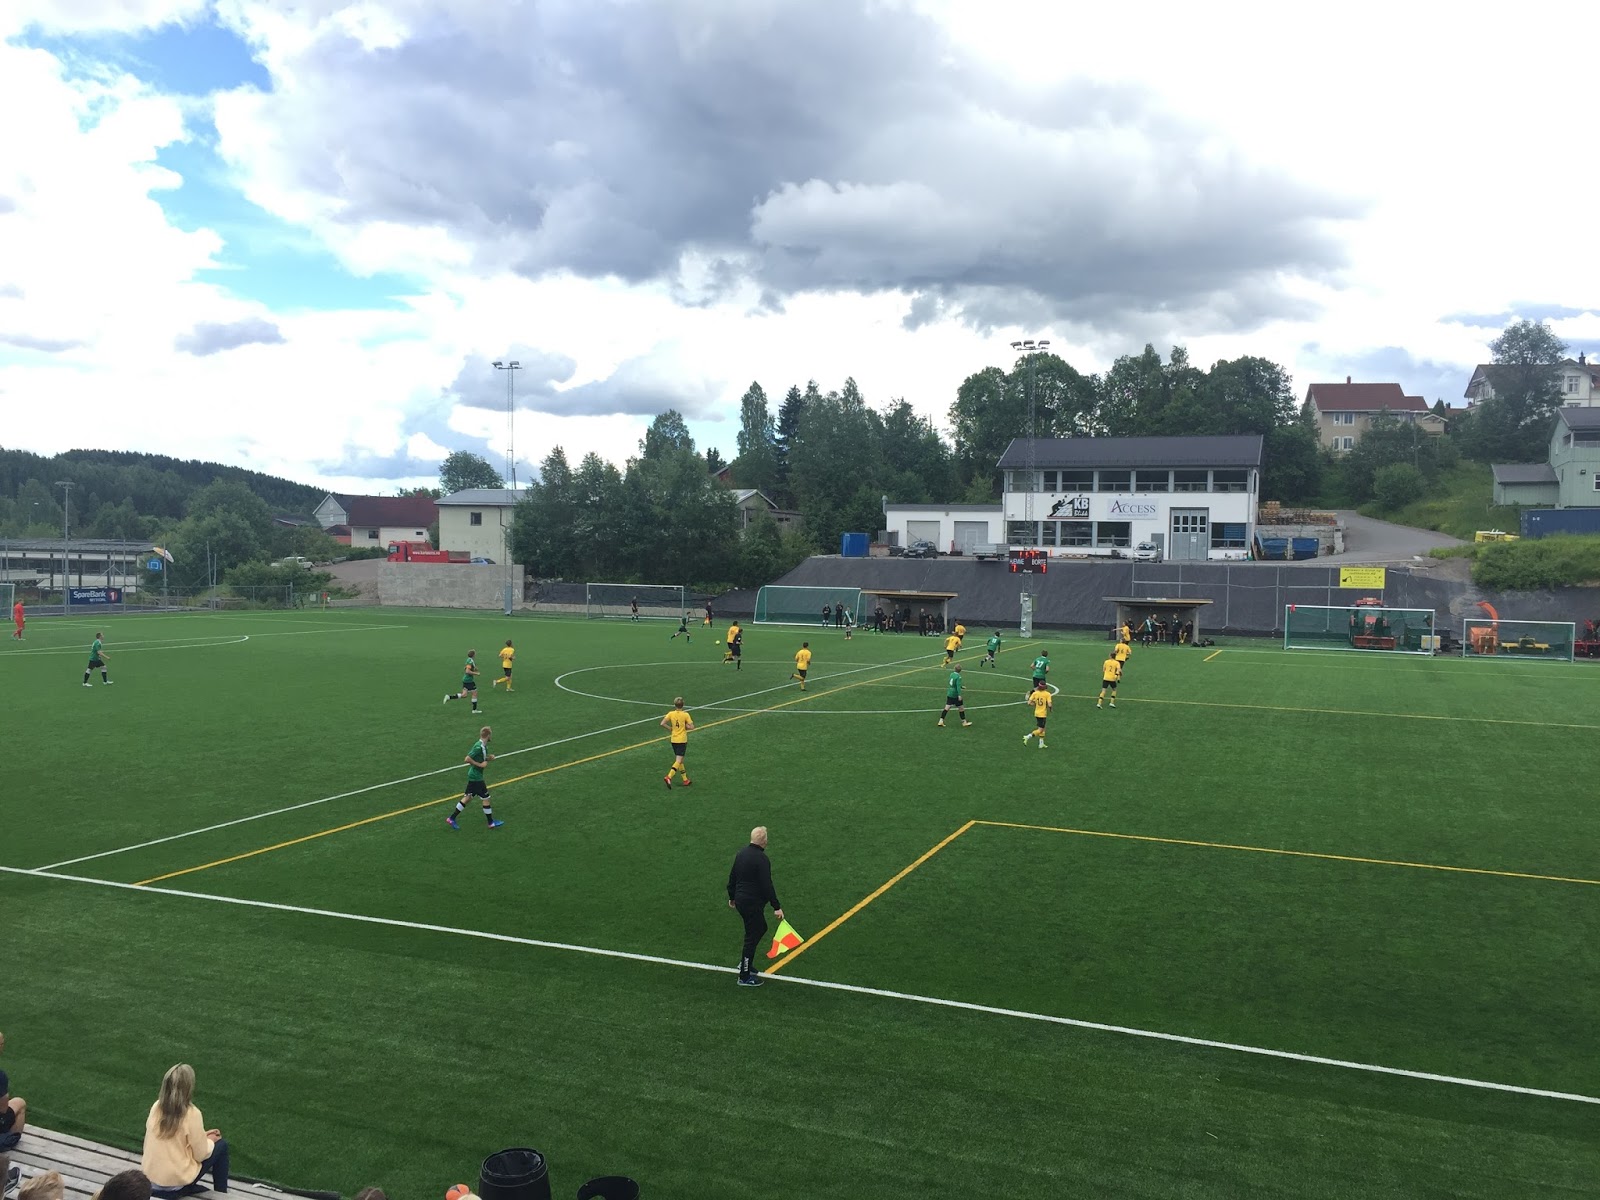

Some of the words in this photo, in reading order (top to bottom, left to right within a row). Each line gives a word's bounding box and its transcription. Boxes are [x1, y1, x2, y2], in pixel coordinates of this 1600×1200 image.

[1074, 498, 1089, 510] KB
[1110, 500, 1156, 514] ACCESS
[73, 590, 107, 600] SpareBank
[1036, 697, 1044, 707] 15
